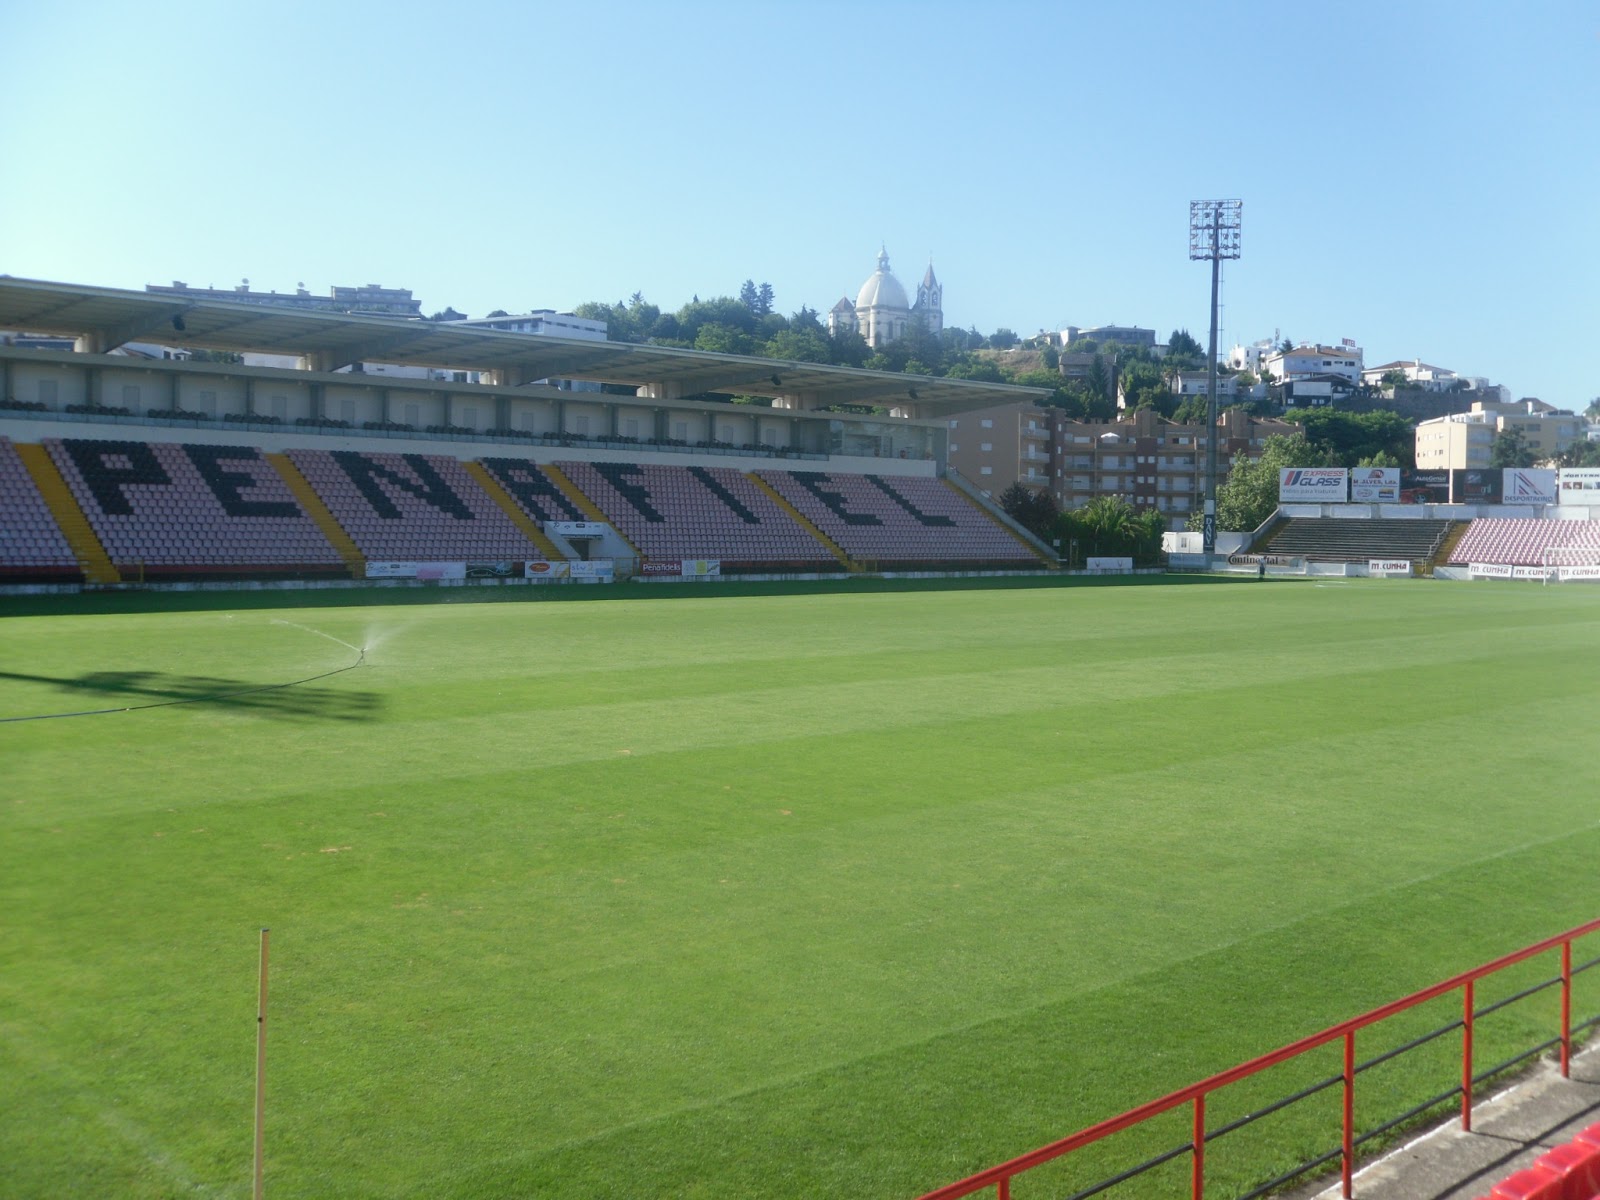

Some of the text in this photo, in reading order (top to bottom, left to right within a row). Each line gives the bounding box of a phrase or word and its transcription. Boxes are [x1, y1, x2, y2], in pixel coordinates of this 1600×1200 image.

[60, 438, 956, 527] PENAFIEL
[1300, 478, 1341, 486] GLASS
[1205, 517, 1213, 545] DANY
[1228, 554, 1279, 565] Continetal
[642, 564, 681, 572] Penafidelis
[1482, 566, 1509, 574] CUNHA
